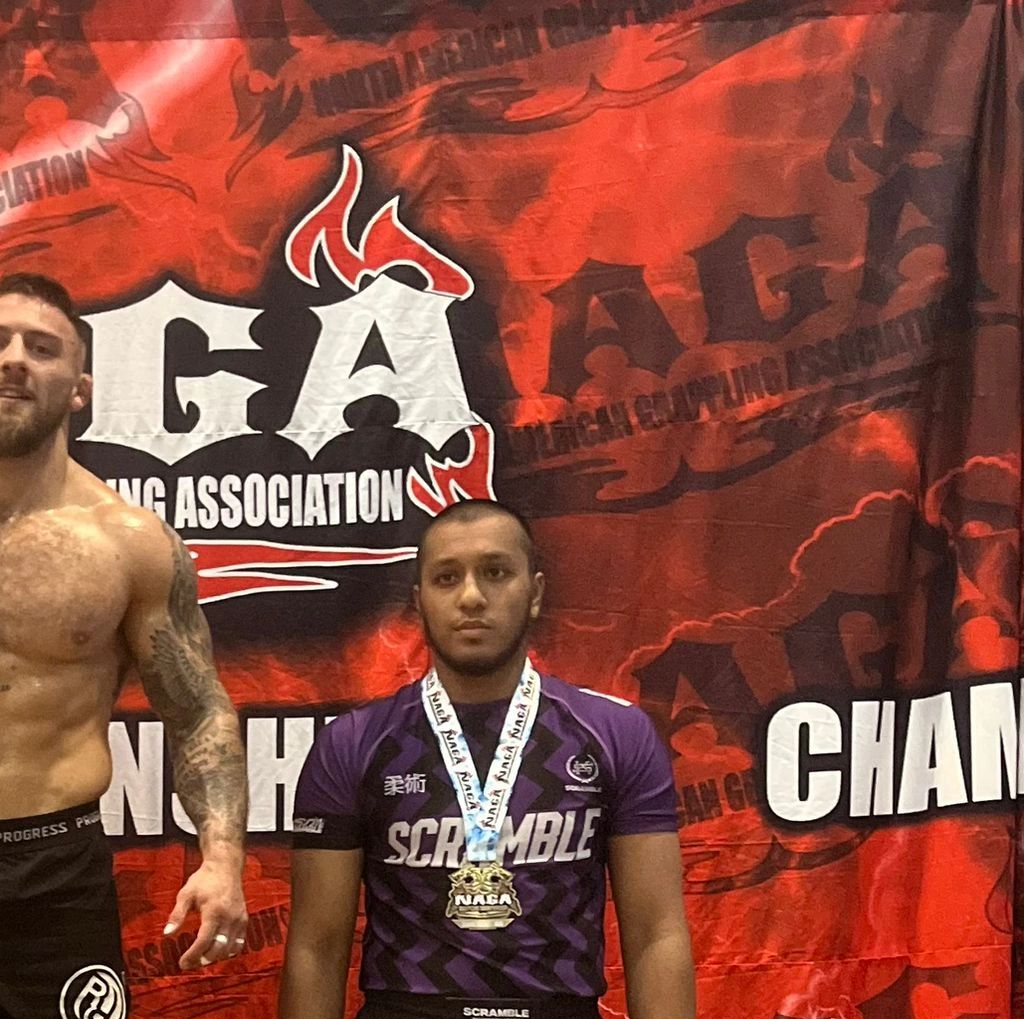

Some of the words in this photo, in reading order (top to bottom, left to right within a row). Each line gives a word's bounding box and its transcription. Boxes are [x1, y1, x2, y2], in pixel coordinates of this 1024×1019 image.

[174, 468, 404, 530] ASSOCIATION
[431, 690, 450, 724] NAGA
[511, 703, 528, 739] NAGA
[445, 729, 466, 766] NAGA
[498, 745, 515, 783] NAGA
[384, 774, 426, 796] 柔術
[459, 771, 478, 811] NAGA
[484, 789, 502, 829] NAGA
[384, 808, 602, 869] SCRMBLE
[454, 893, 513, 907] NAGA
[462, 1006, 530, 1018] SCRAMBLE
